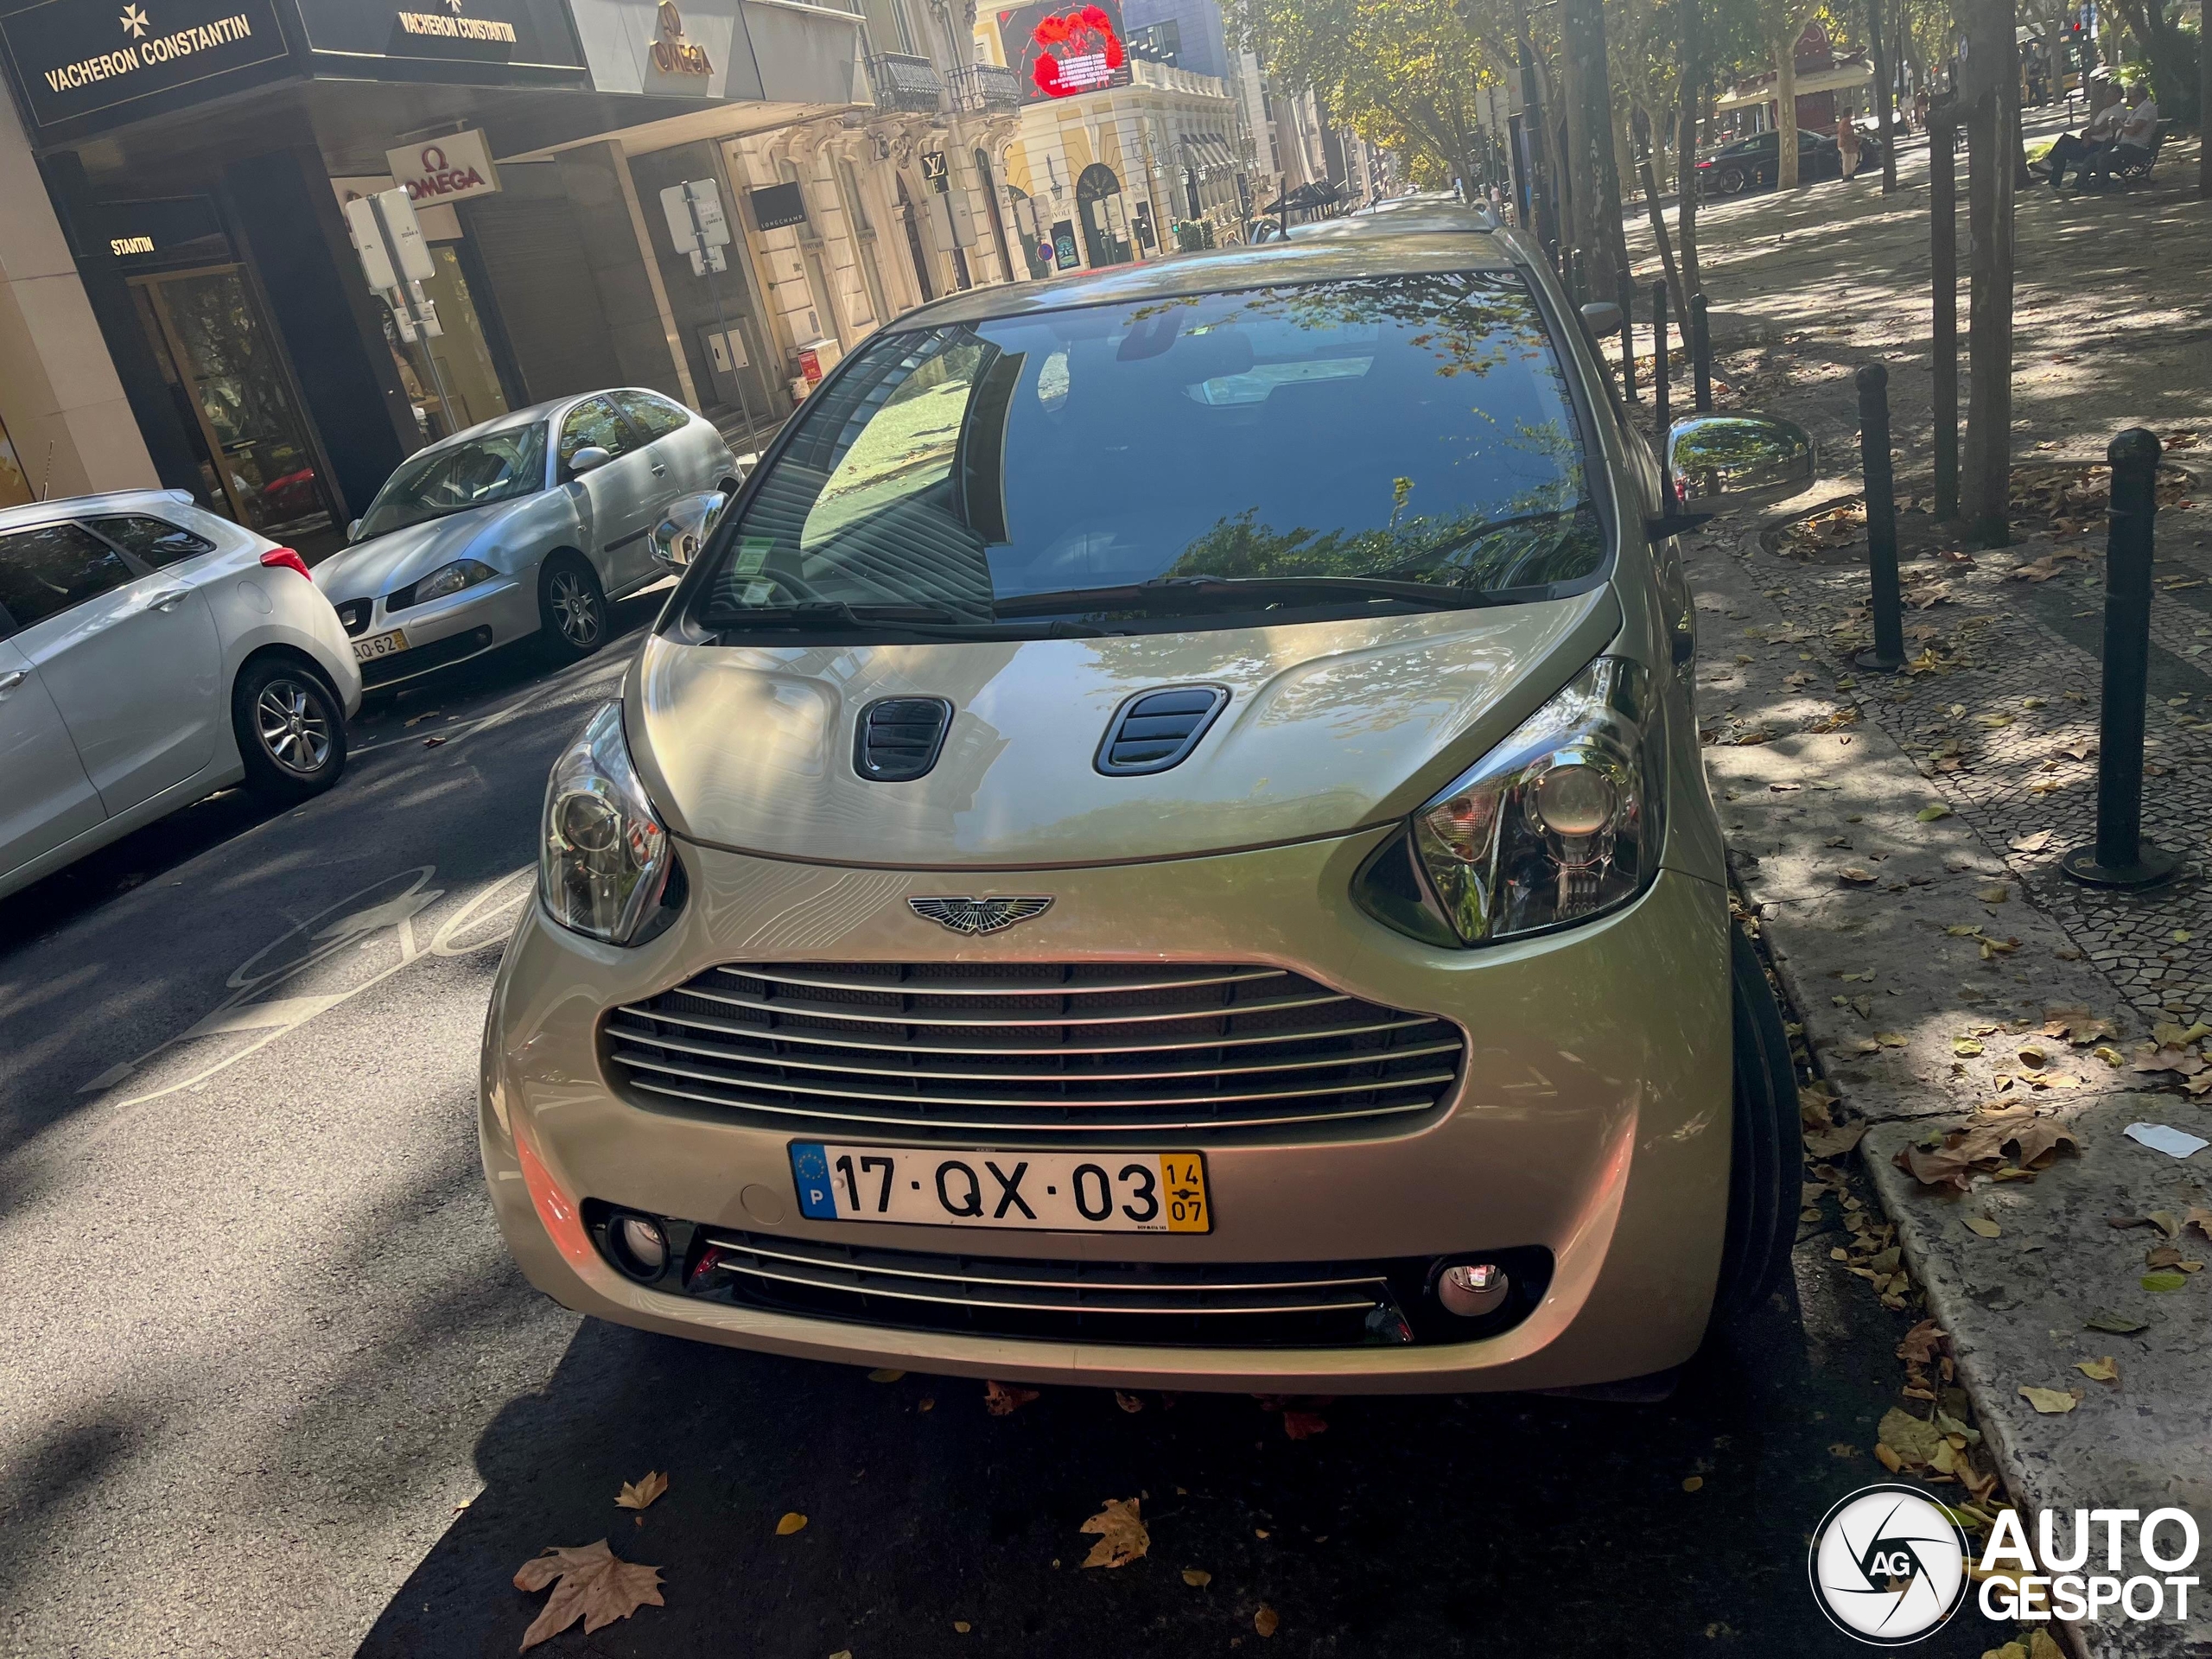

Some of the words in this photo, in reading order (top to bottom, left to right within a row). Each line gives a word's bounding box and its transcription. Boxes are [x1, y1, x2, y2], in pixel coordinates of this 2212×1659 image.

[398, 11, 459, 37] VACHERON
[455, 17, 517, 42] CONSTANTIN
[44, 47, 140, 92] VACHERON
[141, 14, 251, 66] CONSTANTIN
[650, 40, 715, 75] OMEGA
[406, 167, 486, 200] OMEGA
[760, 214, 804, 229] LONGCHAMP
[1051, 208, 1071, 219] IVOLI
[111, 235, 155, 257] STANTIN
[1166, 1163, 1199, 1185] 14
[810, 1189, 823, 1205] P
[1172, 1201, 1203, 1222] 07
